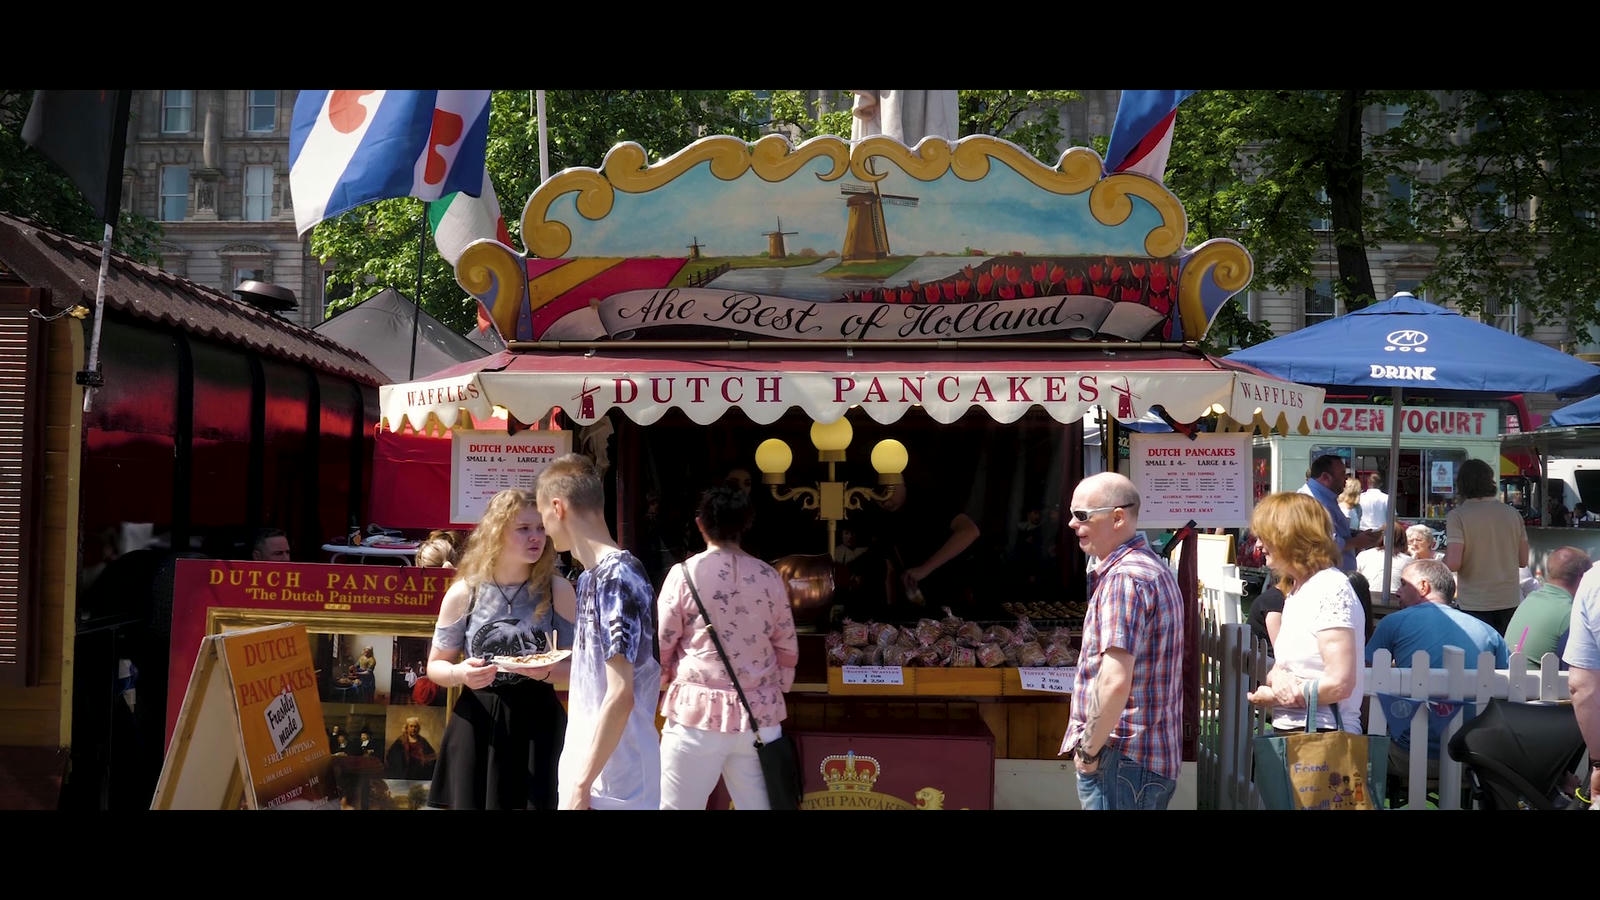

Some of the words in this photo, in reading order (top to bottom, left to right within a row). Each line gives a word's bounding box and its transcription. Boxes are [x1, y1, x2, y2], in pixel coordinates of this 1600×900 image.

[703, 293, 822, 333] Best
[840, 304, 890, 339] of
[898, 296, 1083, 337] Holland
[1369, 364, 1436, 380] DRINK
[406, 382, 480, 408] WAFFLES
[612, 377, 783, 404] DUTCH
[832, 375, 1099, 403] PANCAKES
[1240, 382, 1304, 409] WAFFLES
[1314, 407, 1385, 432] OZEN
[466, 455, 487, 463] SMALL
[469, 444, 502, 453] DUTCH
[505, 445, 555, 455] PANCAKES
[1147, 448, 1180, 457] DUTCH
[1185, 448, 1236, 457] PANCAKES
[209, 569, 301, 588] DUTCH
[326, 573, 453, 593] PANCAKE
[245, 587, 277, 600] "The
[281, 588, 325, 602] Dutch
[329, 590, 391, 605] Painters
[394, 592, 434, 606] Stall"
[243, 635, 298, 668] DUTCH
[239, 666, 314, 707] PANCAKES
[267, 694, 296, 730] Freshly
[278, 715, 298, 745] made
[267, 751, 285, 765] FREE
[285, 739, 317, 758] TOPPINGS
